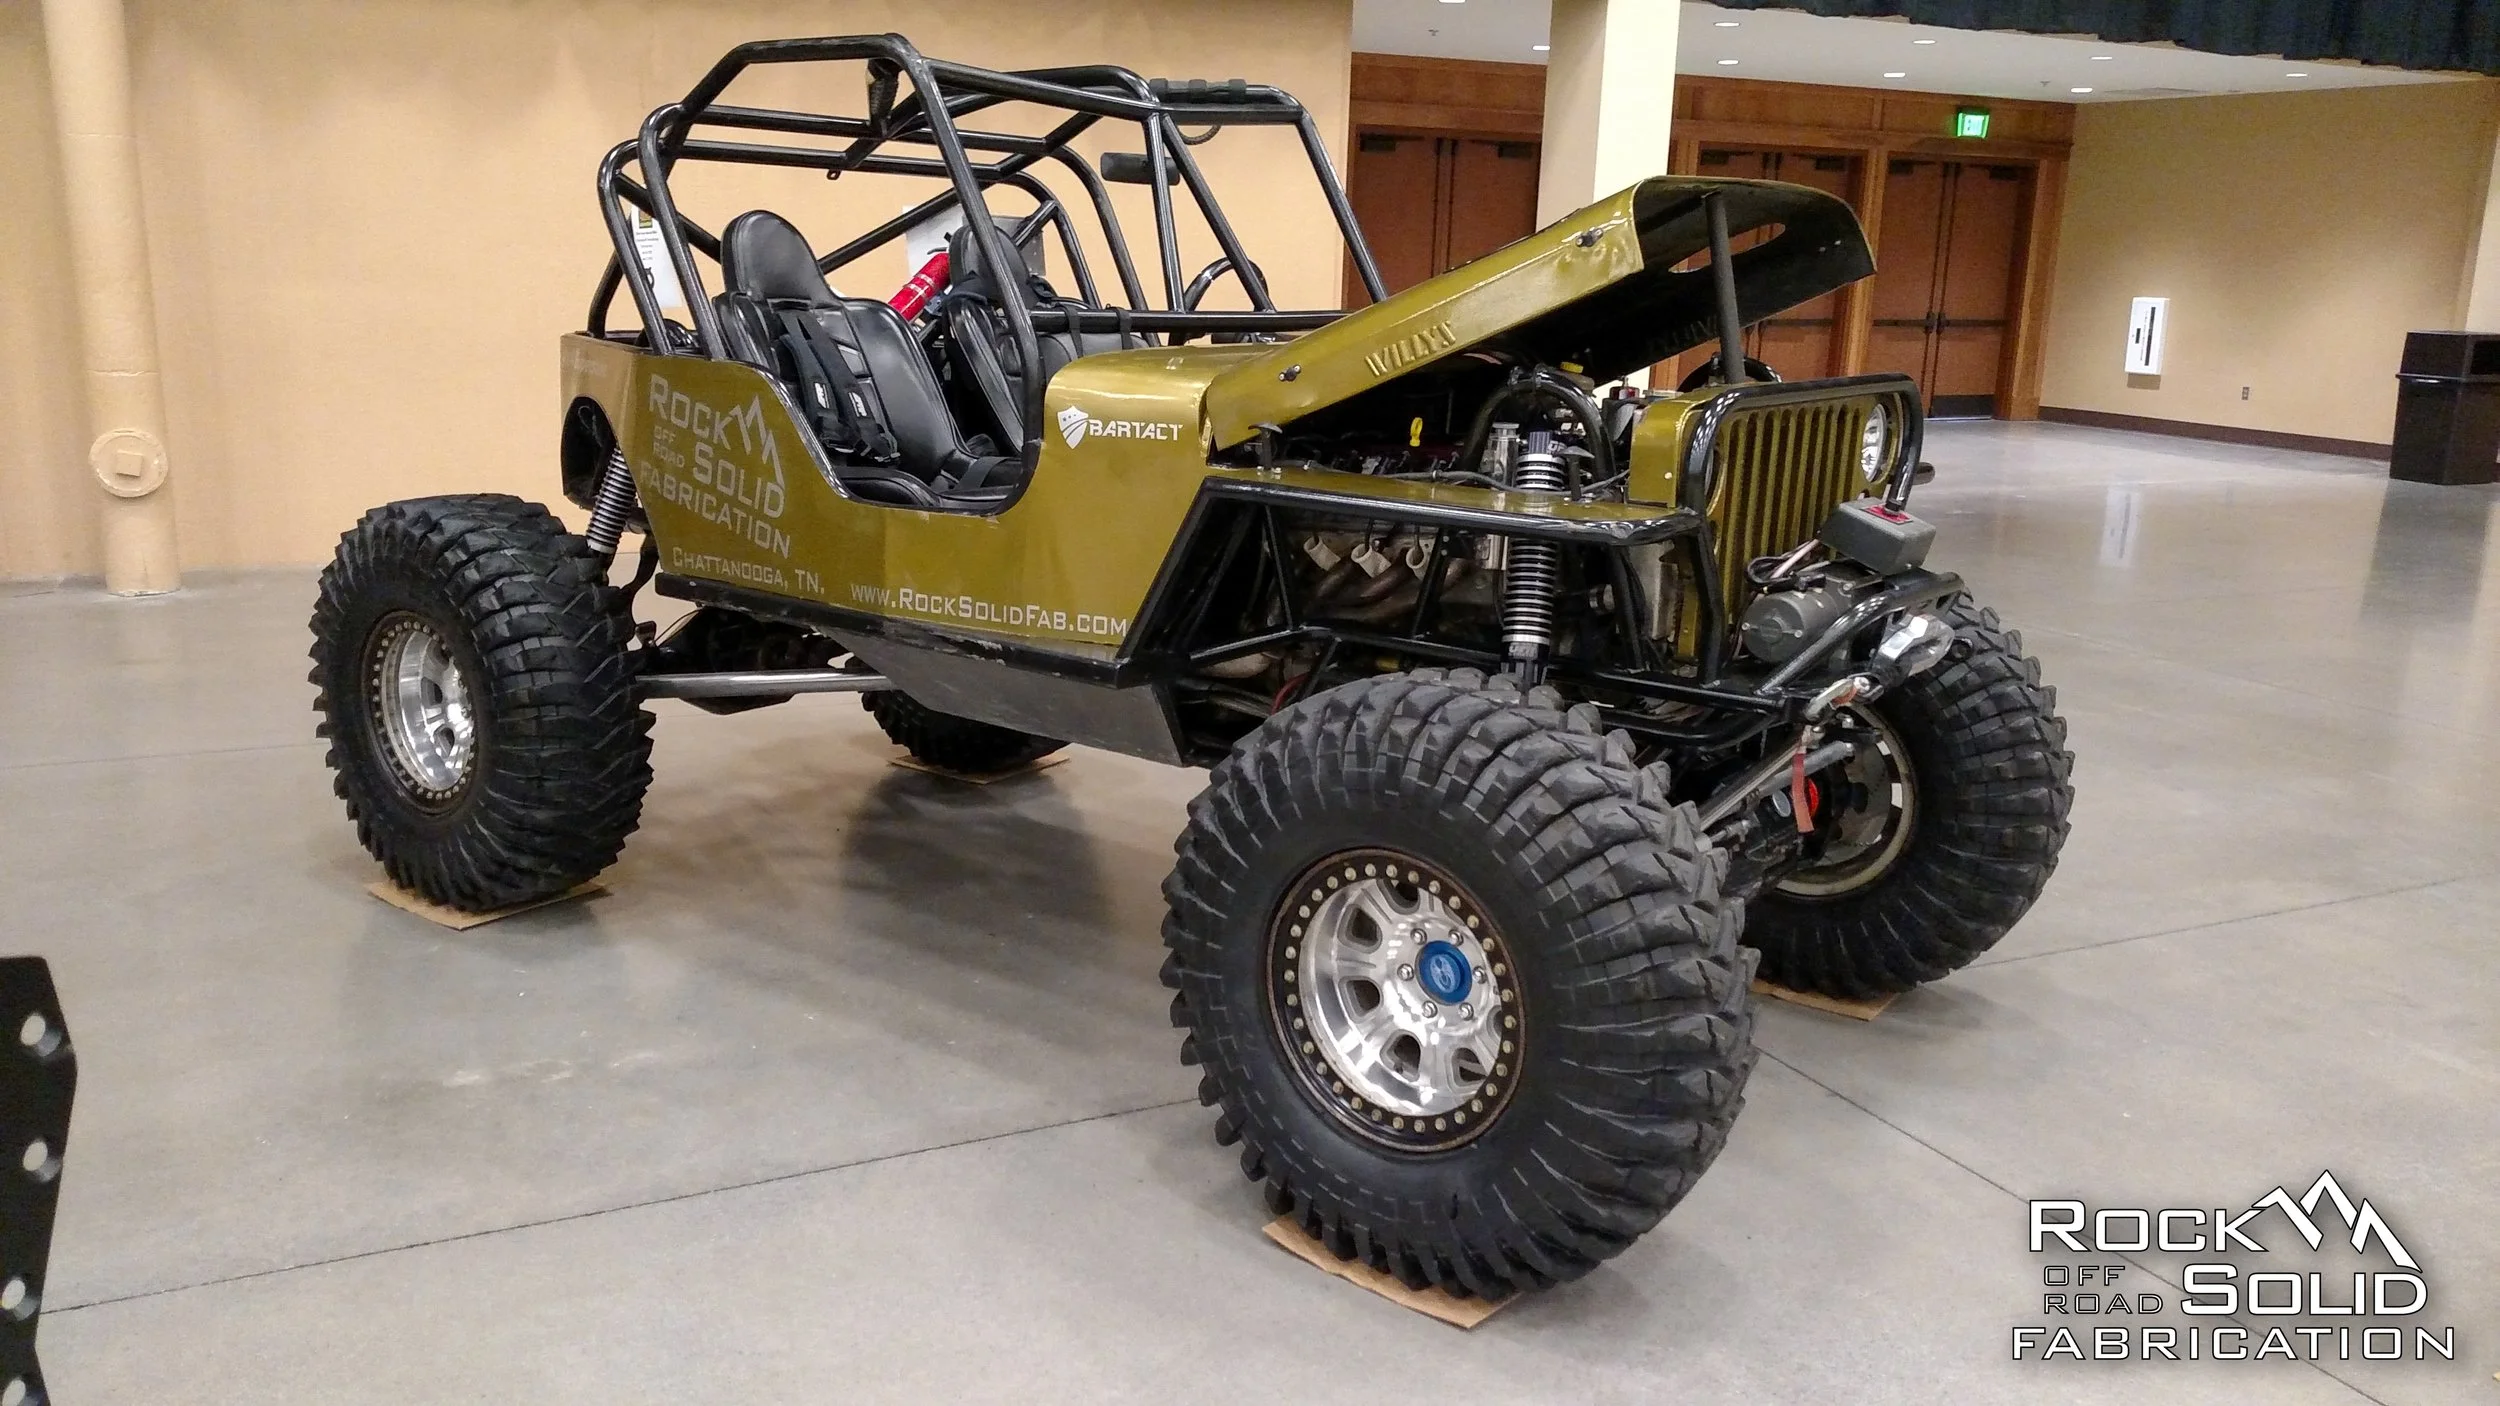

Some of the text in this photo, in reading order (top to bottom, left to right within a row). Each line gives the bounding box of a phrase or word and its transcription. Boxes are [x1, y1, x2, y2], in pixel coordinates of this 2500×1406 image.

[649, 374, 732, 450] ROCK
[653, 425, 677, 443] OFF
[1088, 419, 1184, 441] BARTACT
[652, 441, 685, 468] ROAD
[692, 442, 785, 518] SOLID
[640, 460, 791, 559] FABRICATION
[672, 547, 789, 591] CHATTANOOGA,
